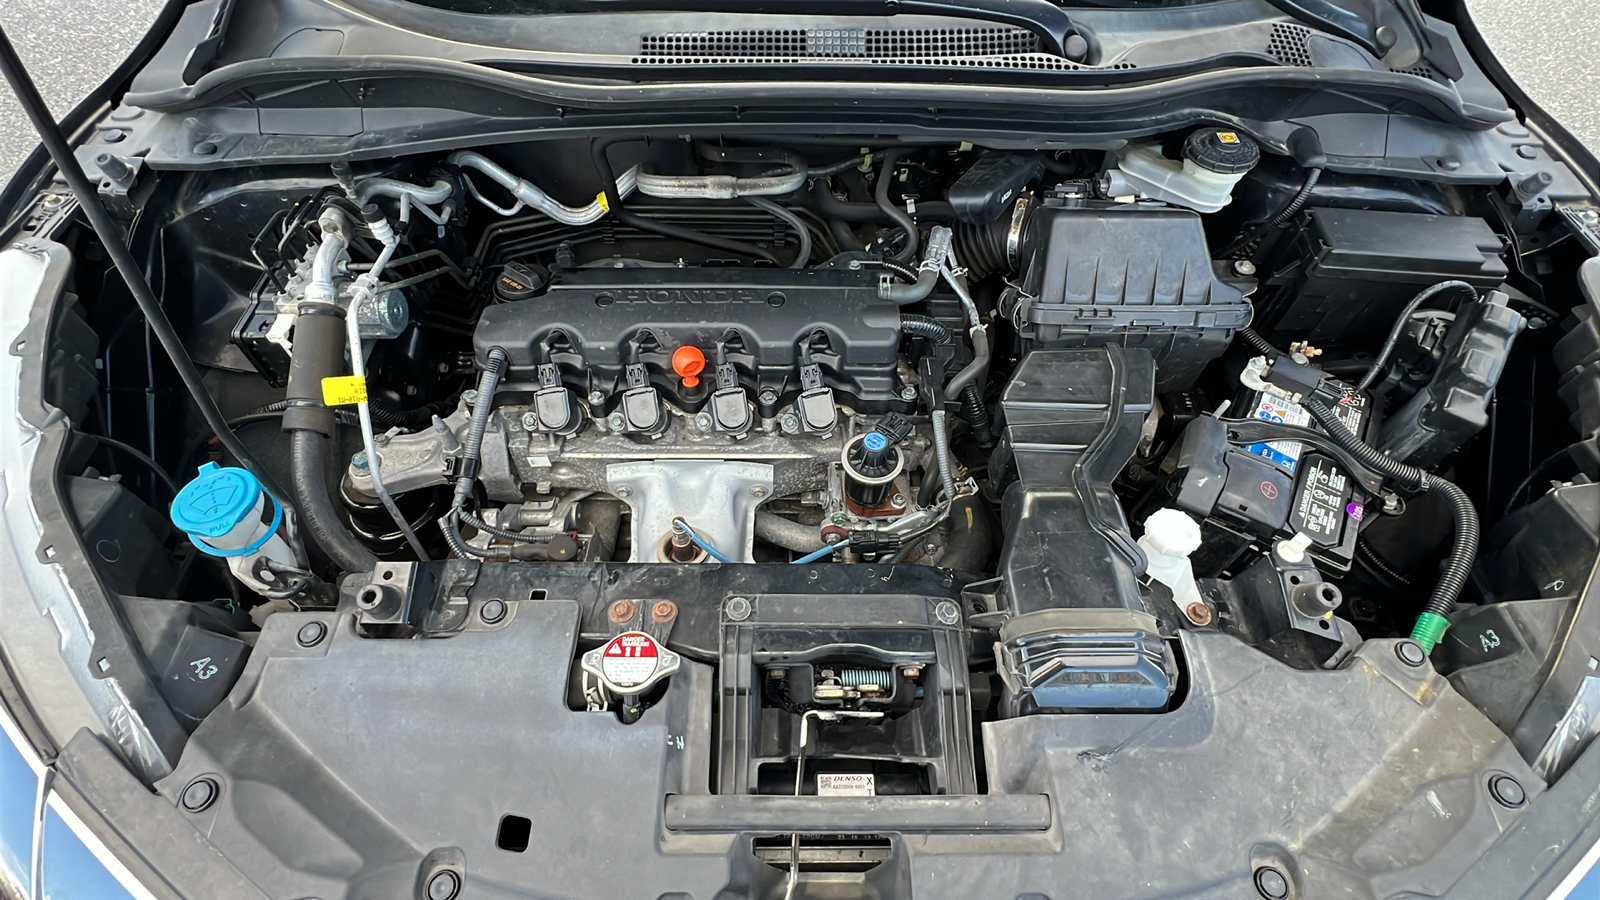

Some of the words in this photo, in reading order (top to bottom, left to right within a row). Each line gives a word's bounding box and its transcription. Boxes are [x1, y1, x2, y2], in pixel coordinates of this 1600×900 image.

[615, 290, 764, 304] HONDA
[1300, 489, 1311, 513] DANGER
[1307, 466, 1317, 486] POISON
[209, 521, 231, 534] PULL
[1479, 629, 1500, 652] A3
[190, 656, 218, 680] A3
[866, 776, 873, 785] X
